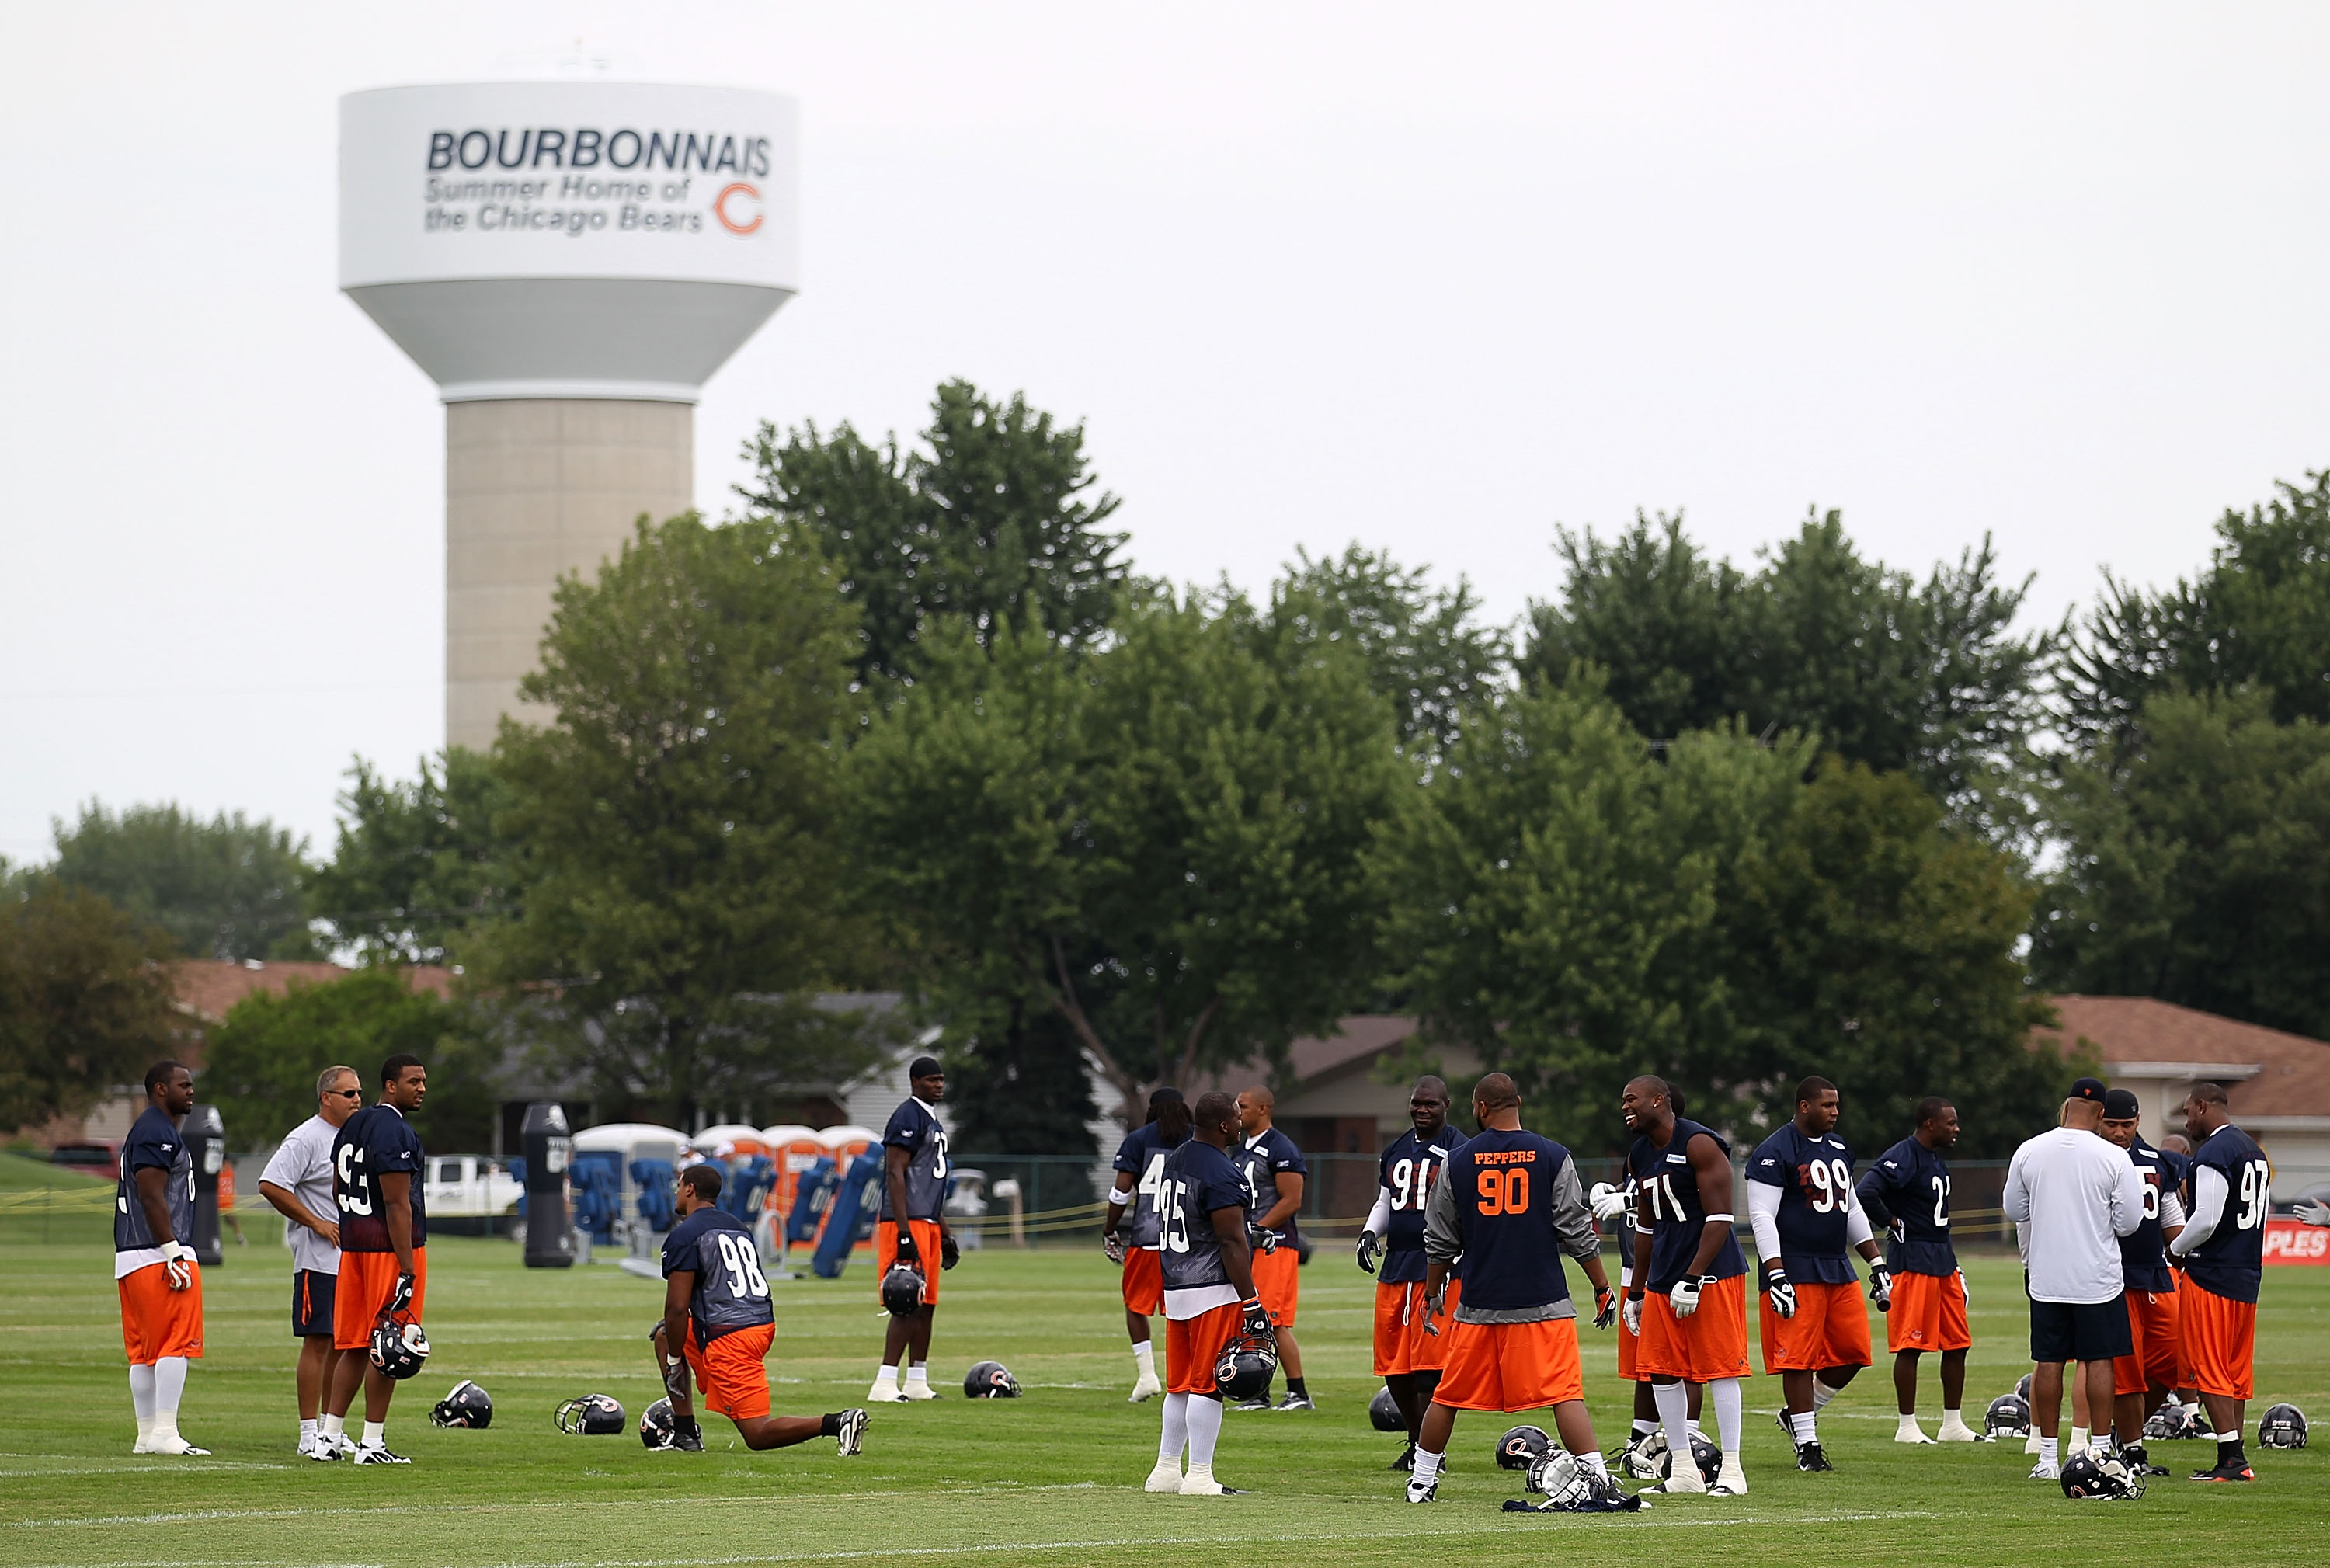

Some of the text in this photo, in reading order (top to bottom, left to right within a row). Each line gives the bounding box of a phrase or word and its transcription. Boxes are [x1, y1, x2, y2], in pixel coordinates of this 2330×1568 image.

[428, 129, 770, 177] BOURBONNAIS
[426, 176, 690, 202] Summer Home of
[713, 183, 764, 235] C
[426, 205, 703, 236] the Chicago Bears
[1139, 1153, 1165, 1212] 4
[1474, 1150, 1535, 1165] PEPPERS
[1390, 1158, 1431, 1211] 91
[1477, 1167, 1529, 1215] 90
[1643, 1173, 1687, 1222] 71
[1810, 1158, 1850, 1213] 99
[2134, 1166, 2159, 1219] 5
[2237, 1159, 2269, 1230] 97
[1159, 1179, 1190, 1253] 95
[718, 1233, 769, 1298] 98
[2264, 1229, 2329, 1258] PLES
